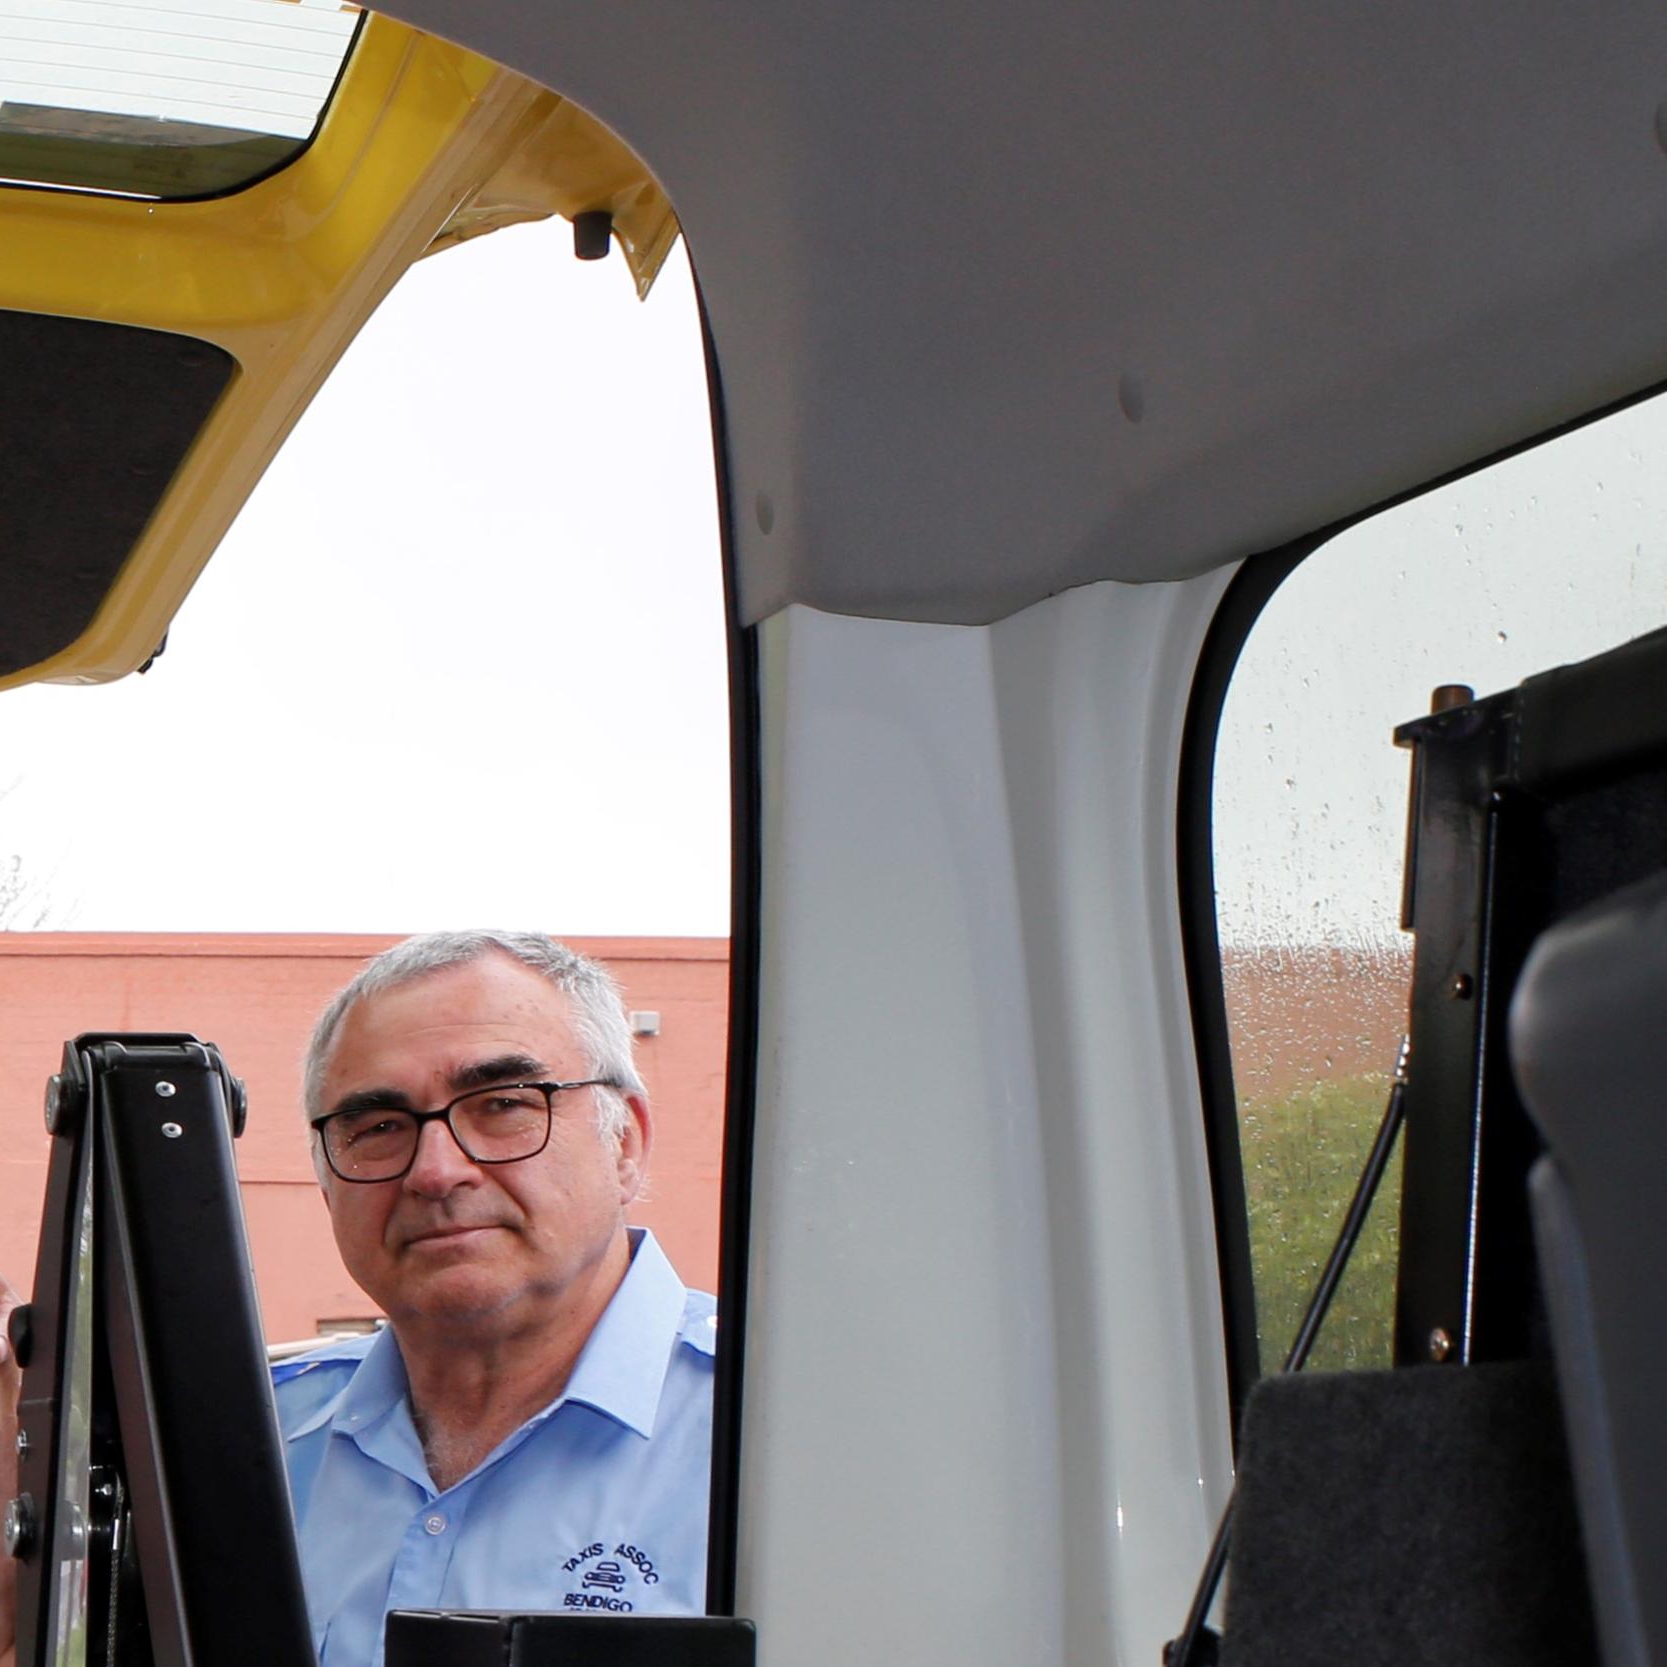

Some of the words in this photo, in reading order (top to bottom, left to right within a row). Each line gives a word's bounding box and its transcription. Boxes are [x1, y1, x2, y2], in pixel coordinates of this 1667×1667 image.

[561, 1542, 604, 1573] TAXIS
[613, 1543, 659, 1585] ASSOC
[563, 1593, 633, 1612] BENDIGO
